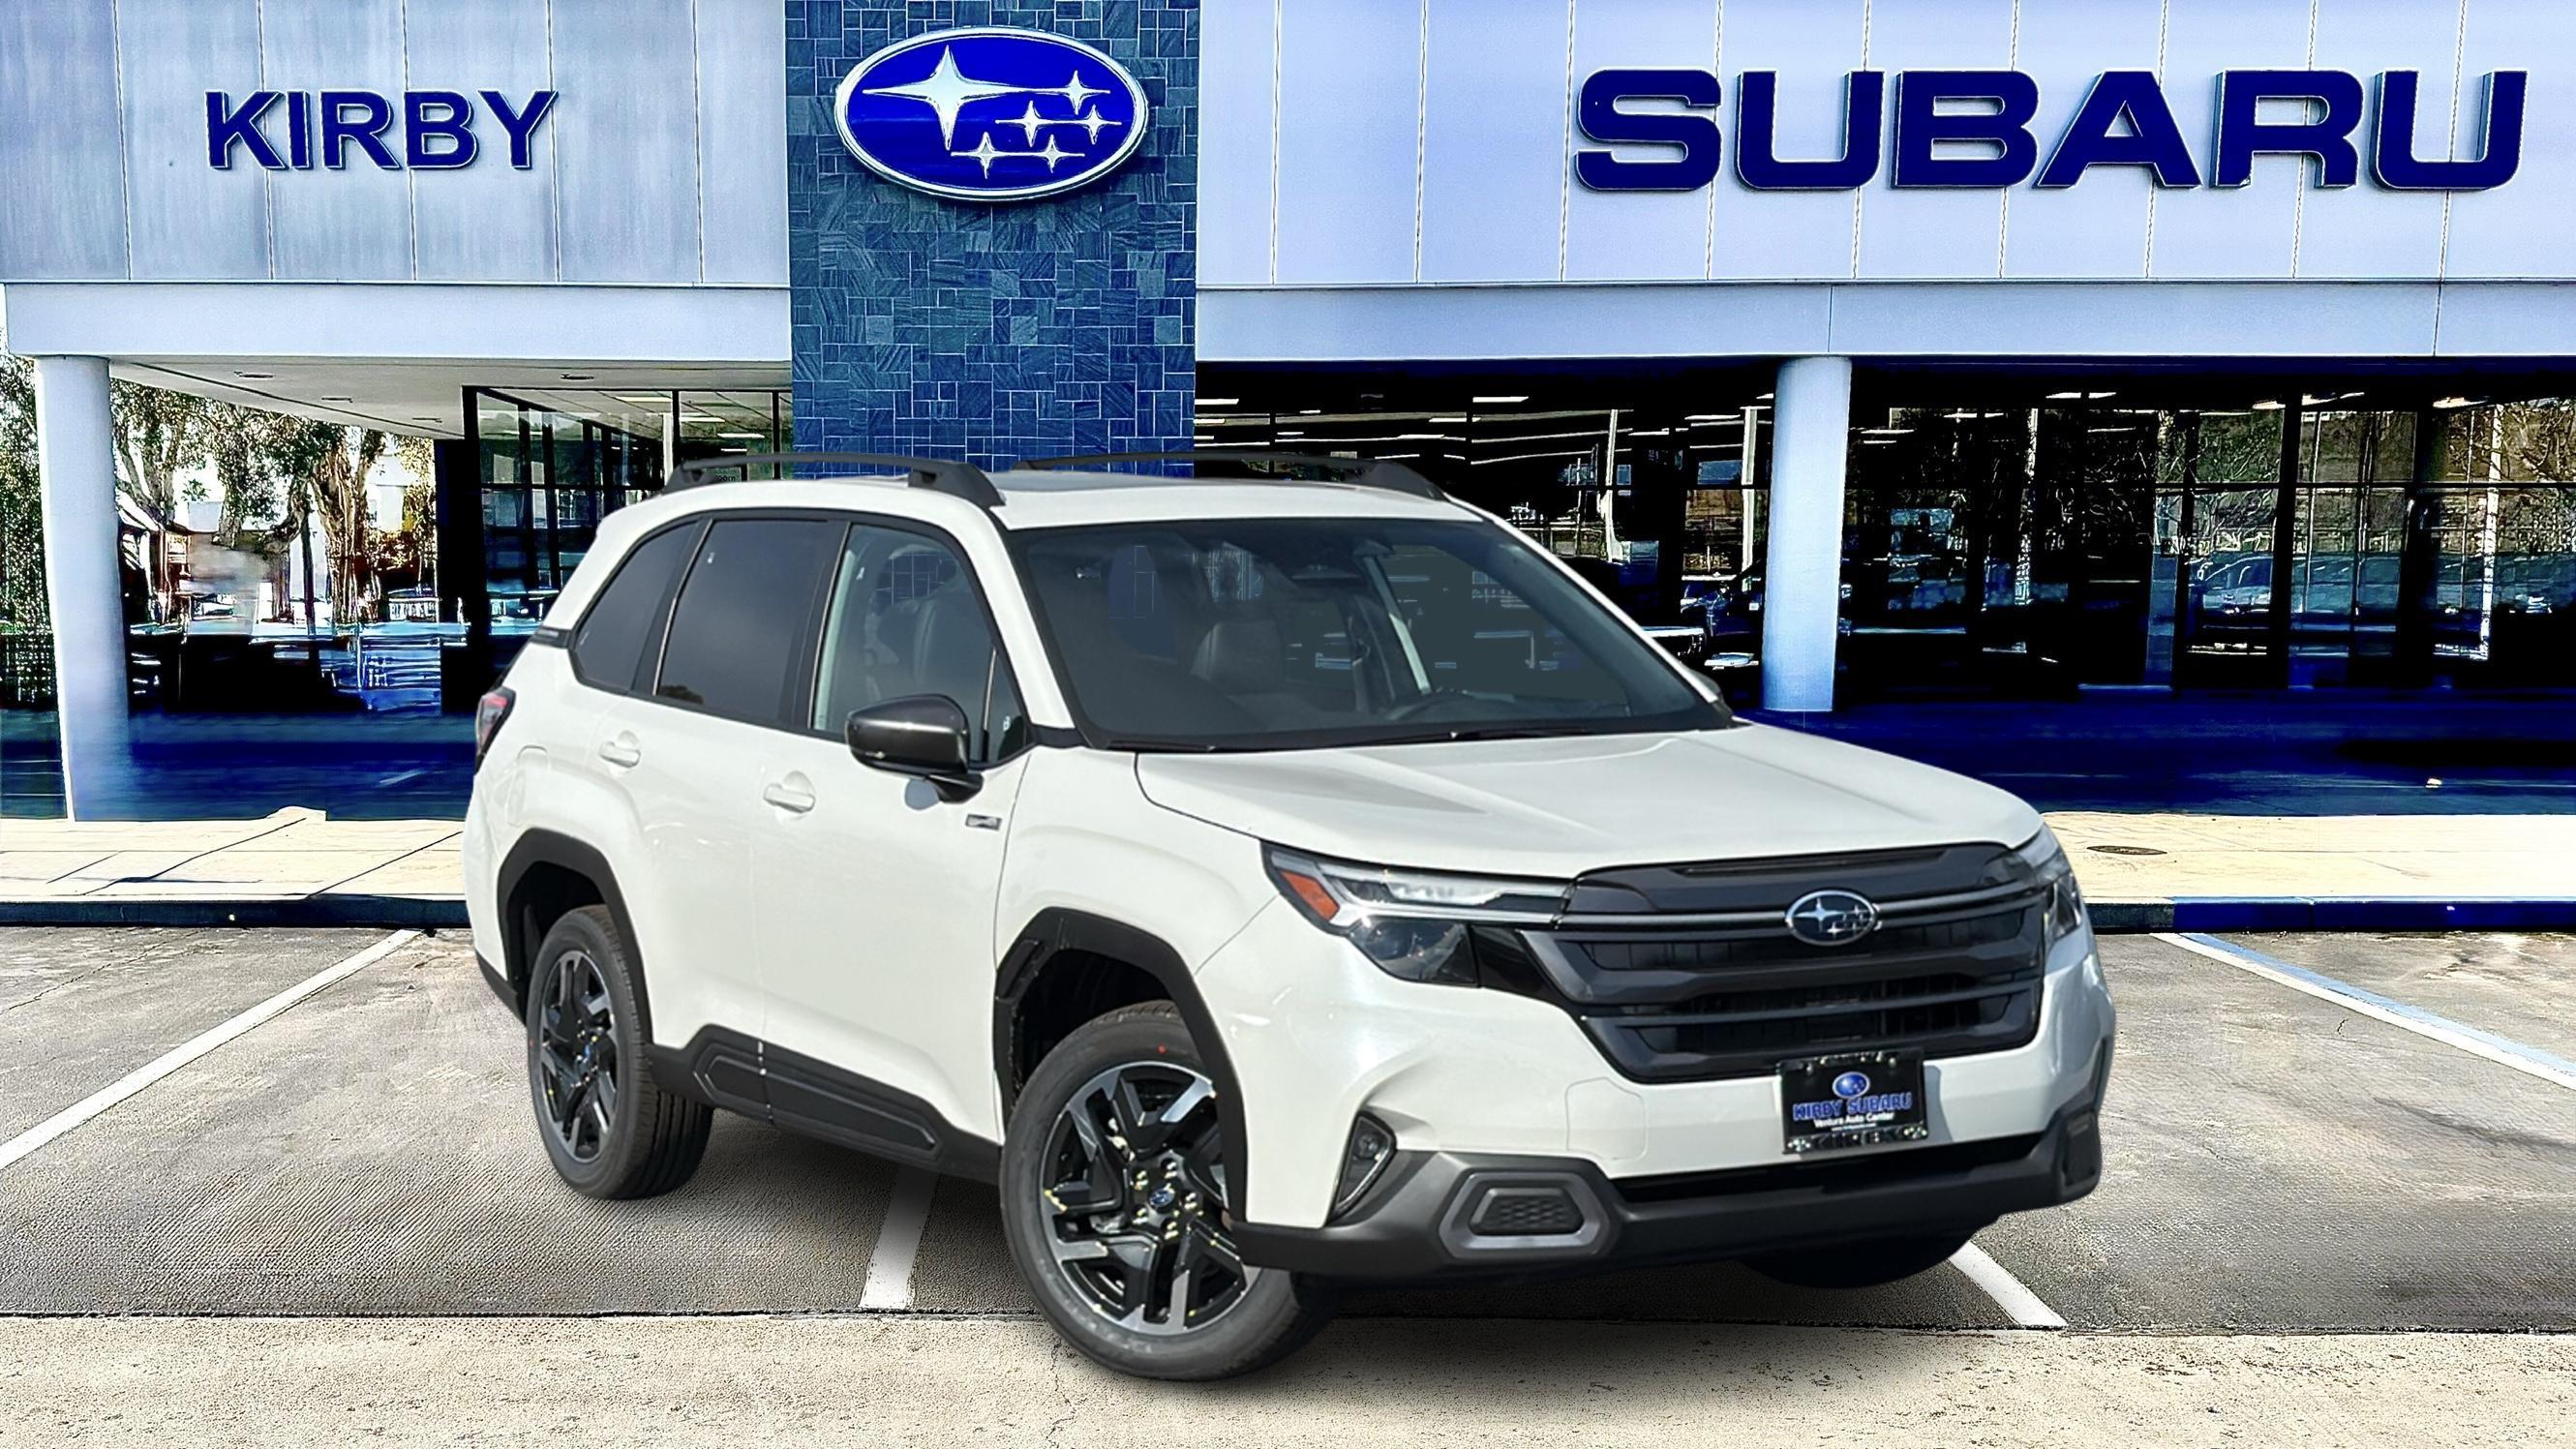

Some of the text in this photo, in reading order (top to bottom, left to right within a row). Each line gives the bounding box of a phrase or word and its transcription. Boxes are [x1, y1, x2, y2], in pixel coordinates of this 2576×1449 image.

[205, 91, 558, 169] KIRBY
[1575, 69, 2527, 191] SUBARU
[1793, 1093, 1912, 1120] KIRBY SUBARU
[1846, 1114, 1864, 1124] Auto
[1866, 1111, 1894, 1122] Center
